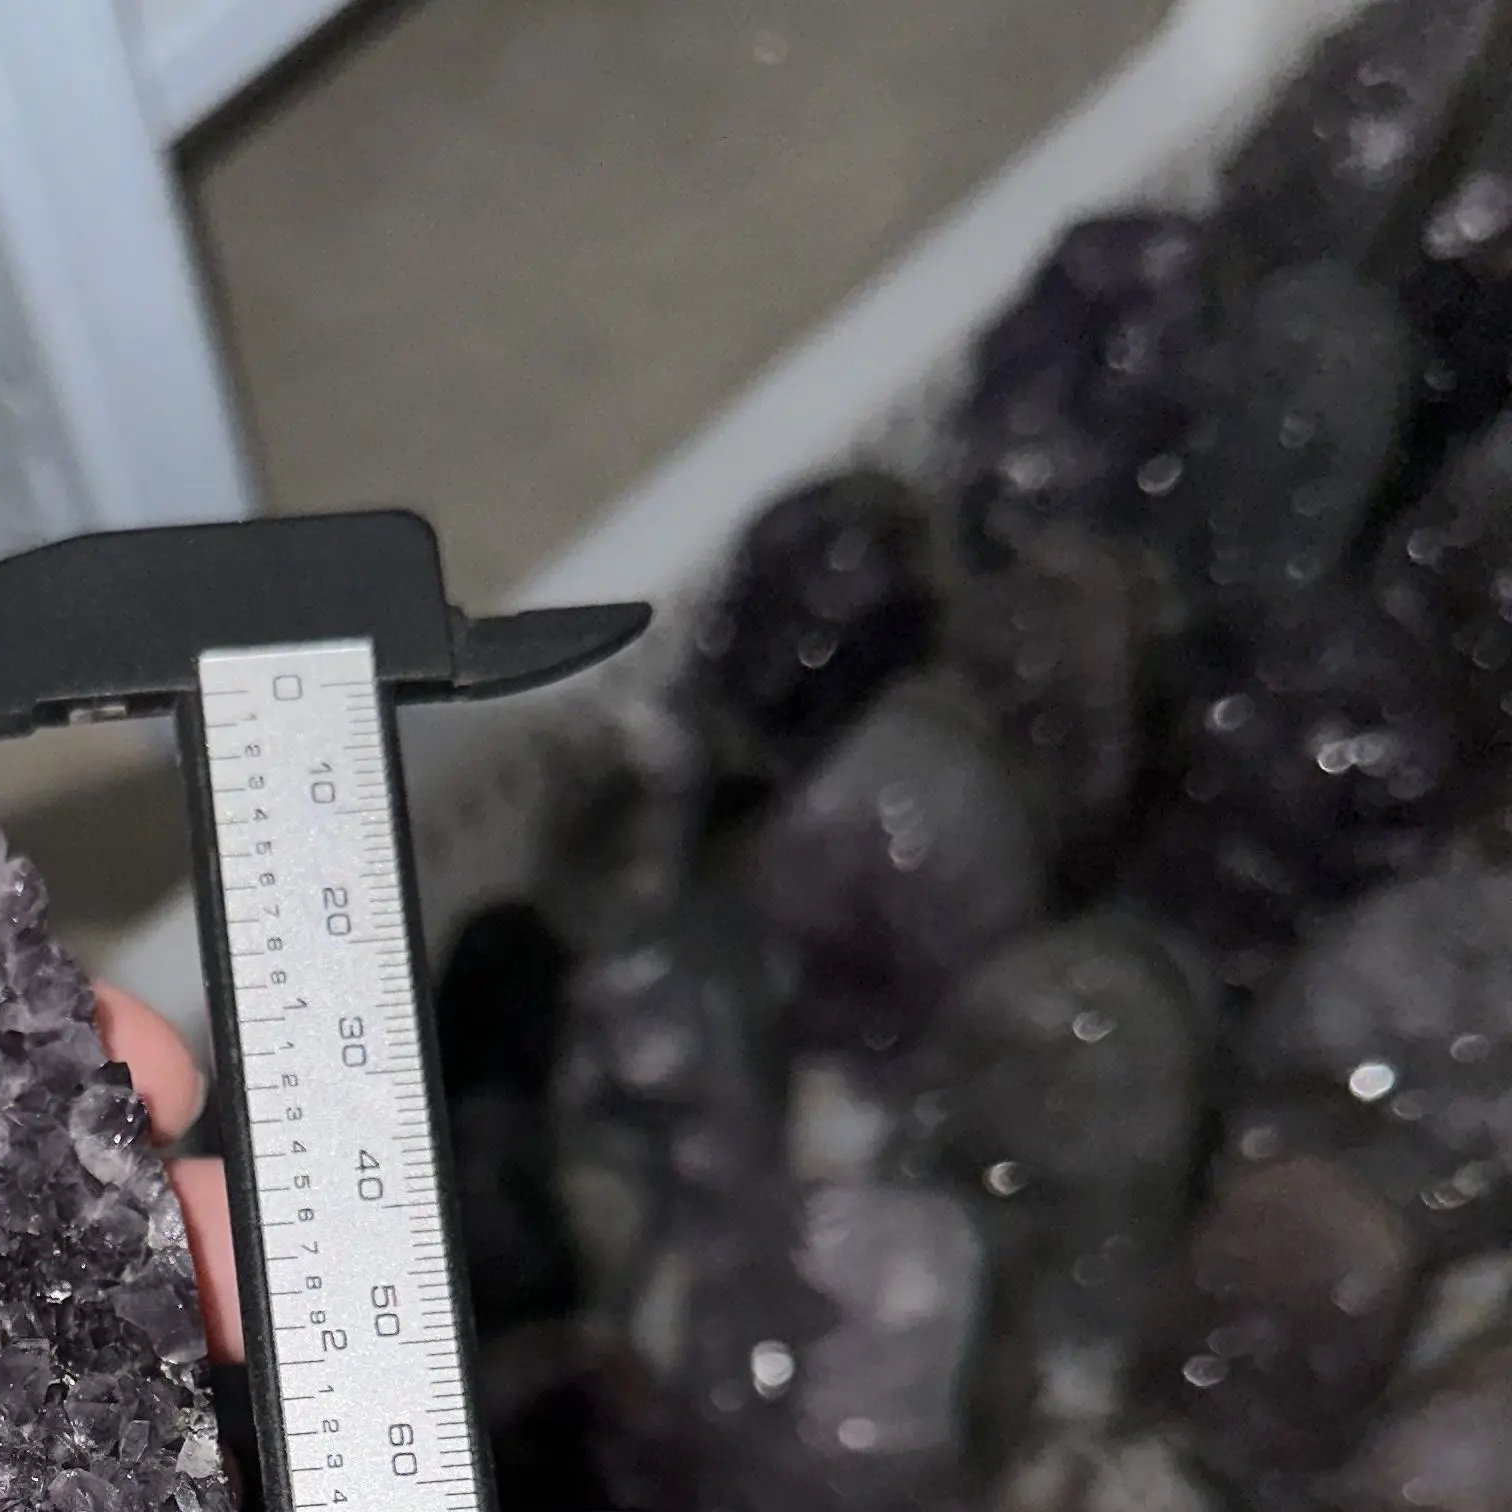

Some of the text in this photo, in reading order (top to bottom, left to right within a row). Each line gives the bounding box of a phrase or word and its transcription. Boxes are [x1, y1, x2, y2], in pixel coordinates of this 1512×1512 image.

[252, 808, 269, 822] 4
[263, 905, 280, 919] 7
[283, 997, 308, 1010] 1
[279, 1041, 295, 1050] 1
[272, 675, 302, 701] 0
[310, 762, 336, 804] 10
[323, 887, 352, 936] 20
[338, 1016, 368, 1068] 30
[354, 1149, 384, 1201] 40
[370, 1285, 401, 1338] 50
[388, 1422, 418, 1477] 60
[281, 1073, 298, 1088] 2
[286, 1106, 303, 1121] 3
[290, 1140, 307, 1154] 4
[294, 1175, 311, 1190] 5
[297, 1208, 314, 1222] 6
[301, 1241, 318, 1255] 7
[306, 1275, 322, 1290] 8
[310, 1310, 327, 1325] 9
[321, 1329, 348, 1353] 2
[318, 1384, 335, 1395] 1
[322, 1418, 340, 1434] 2
[326, 1453, 344, 1470] 3
[332, 1489, 348, 1505] 4
